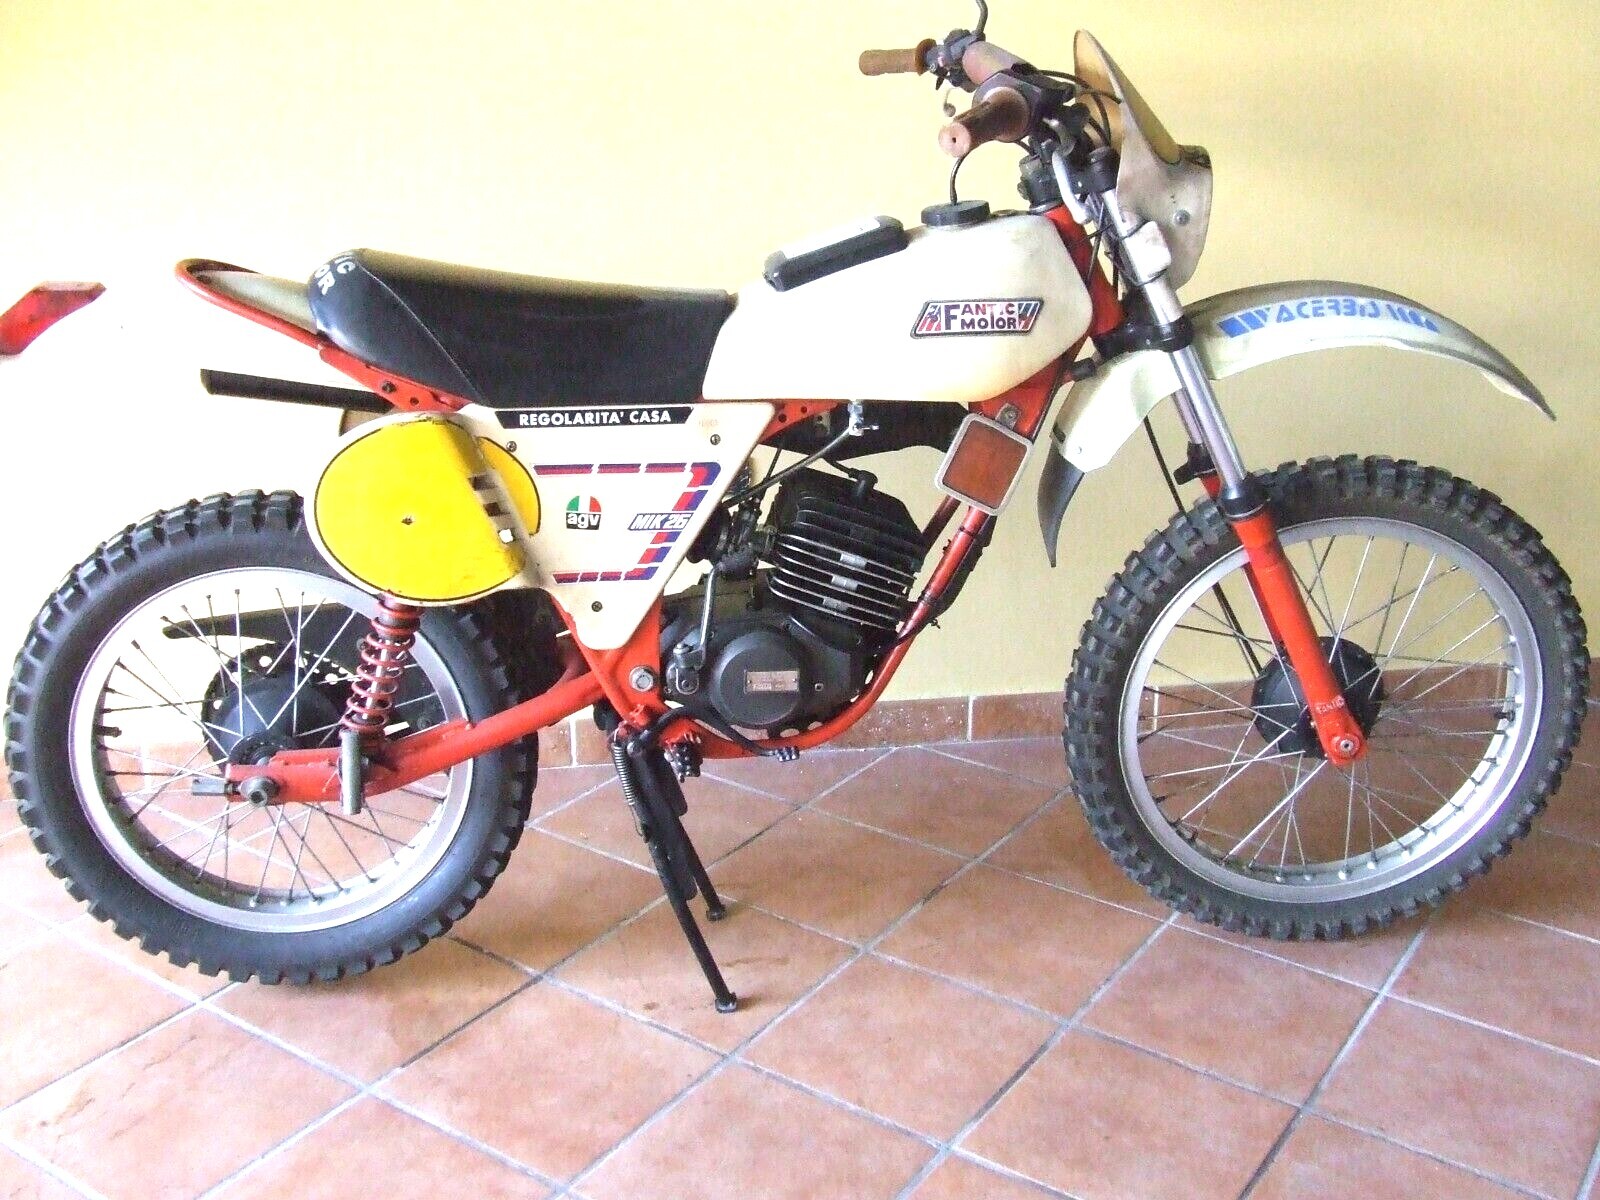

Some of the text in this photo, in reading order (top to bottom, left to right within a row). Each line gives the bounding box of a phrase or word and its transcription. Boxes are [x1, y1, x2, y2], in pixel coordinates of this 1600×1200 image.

[944, 303, 1015, 330] FANTC
[629, 410, 671, 423] CASA
[567, 512, 600, 529] agv
